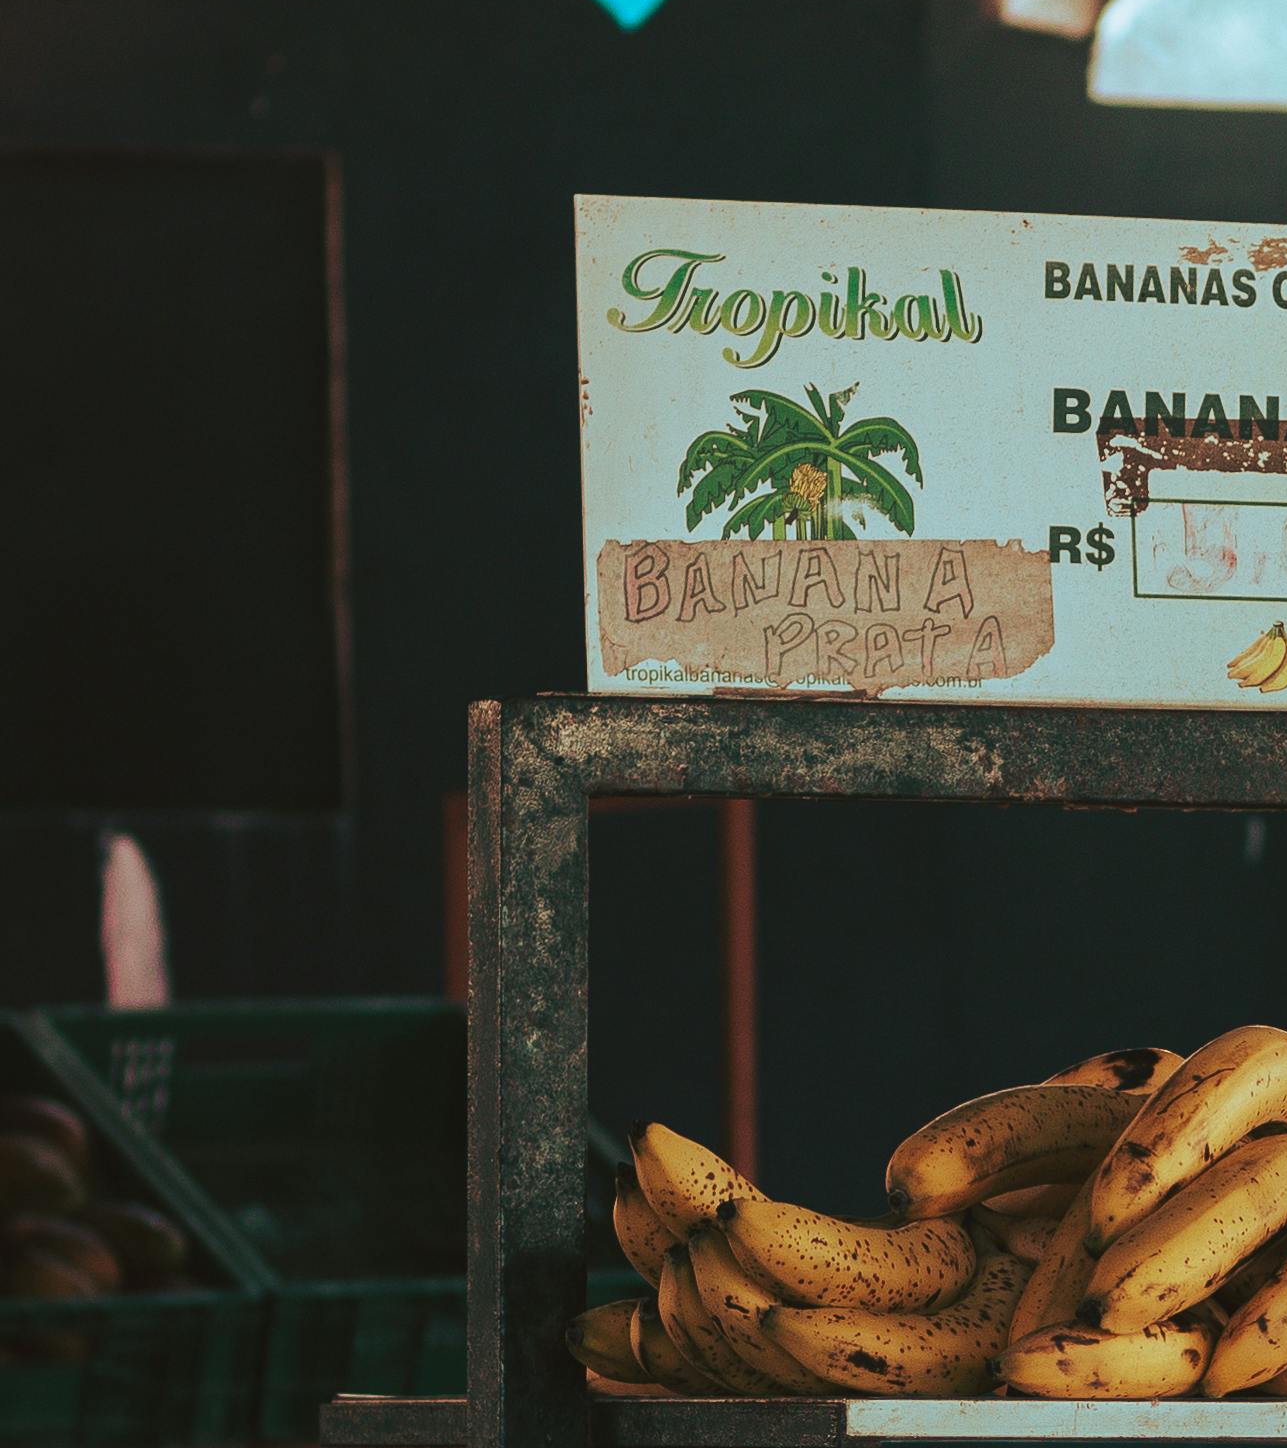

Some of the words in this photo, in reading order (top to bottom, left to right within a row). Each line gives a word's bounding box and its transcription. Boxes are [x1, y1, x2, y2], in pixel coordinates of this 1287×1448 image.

[606, 249, 983, 369] Tropikal
[1044, 261, 1258, 309] BANANAS
[1048, 521, 1116, 572] R$
[624, 541, 975, 623] BANANA
[762, 612, 1009, 679] PRATA
